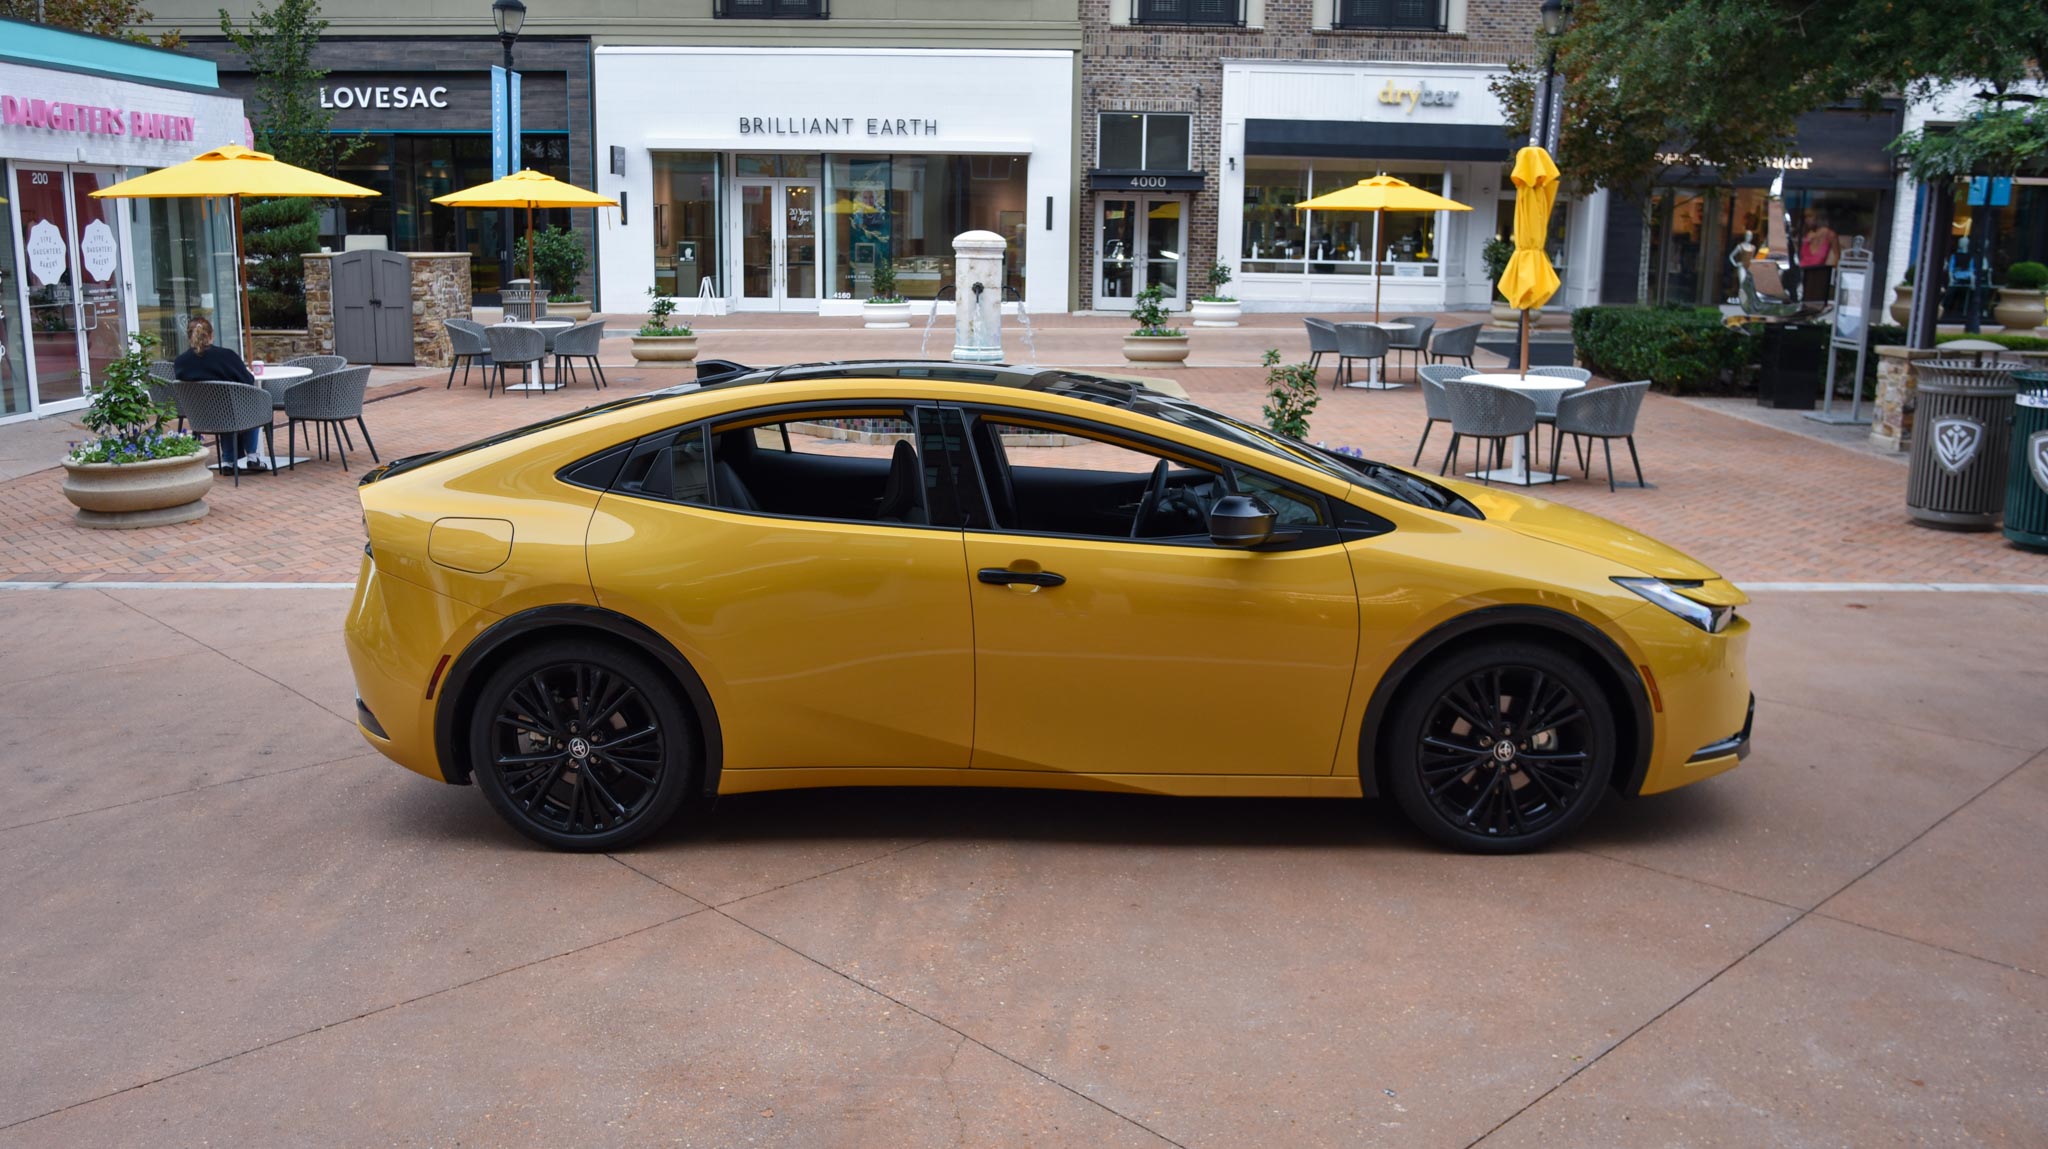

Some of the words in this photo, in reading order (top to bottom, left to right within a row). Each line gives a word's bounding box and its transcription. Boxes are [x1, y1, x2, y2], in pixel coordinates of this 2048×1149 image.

[320, 86, 449, 109] LOVESAC
[1378, 79, 1460, 116] drybar
[1, 95, 126, 136] DAUGHTERS
[130, 111, 195, 141] BAKERY
[739, 117, 854, 135] BRILLIANT
[866, 118, 938, 136] EARTH
[31, 172, 49, 185] 200
[1130, 176, 1167, 188] 4000
